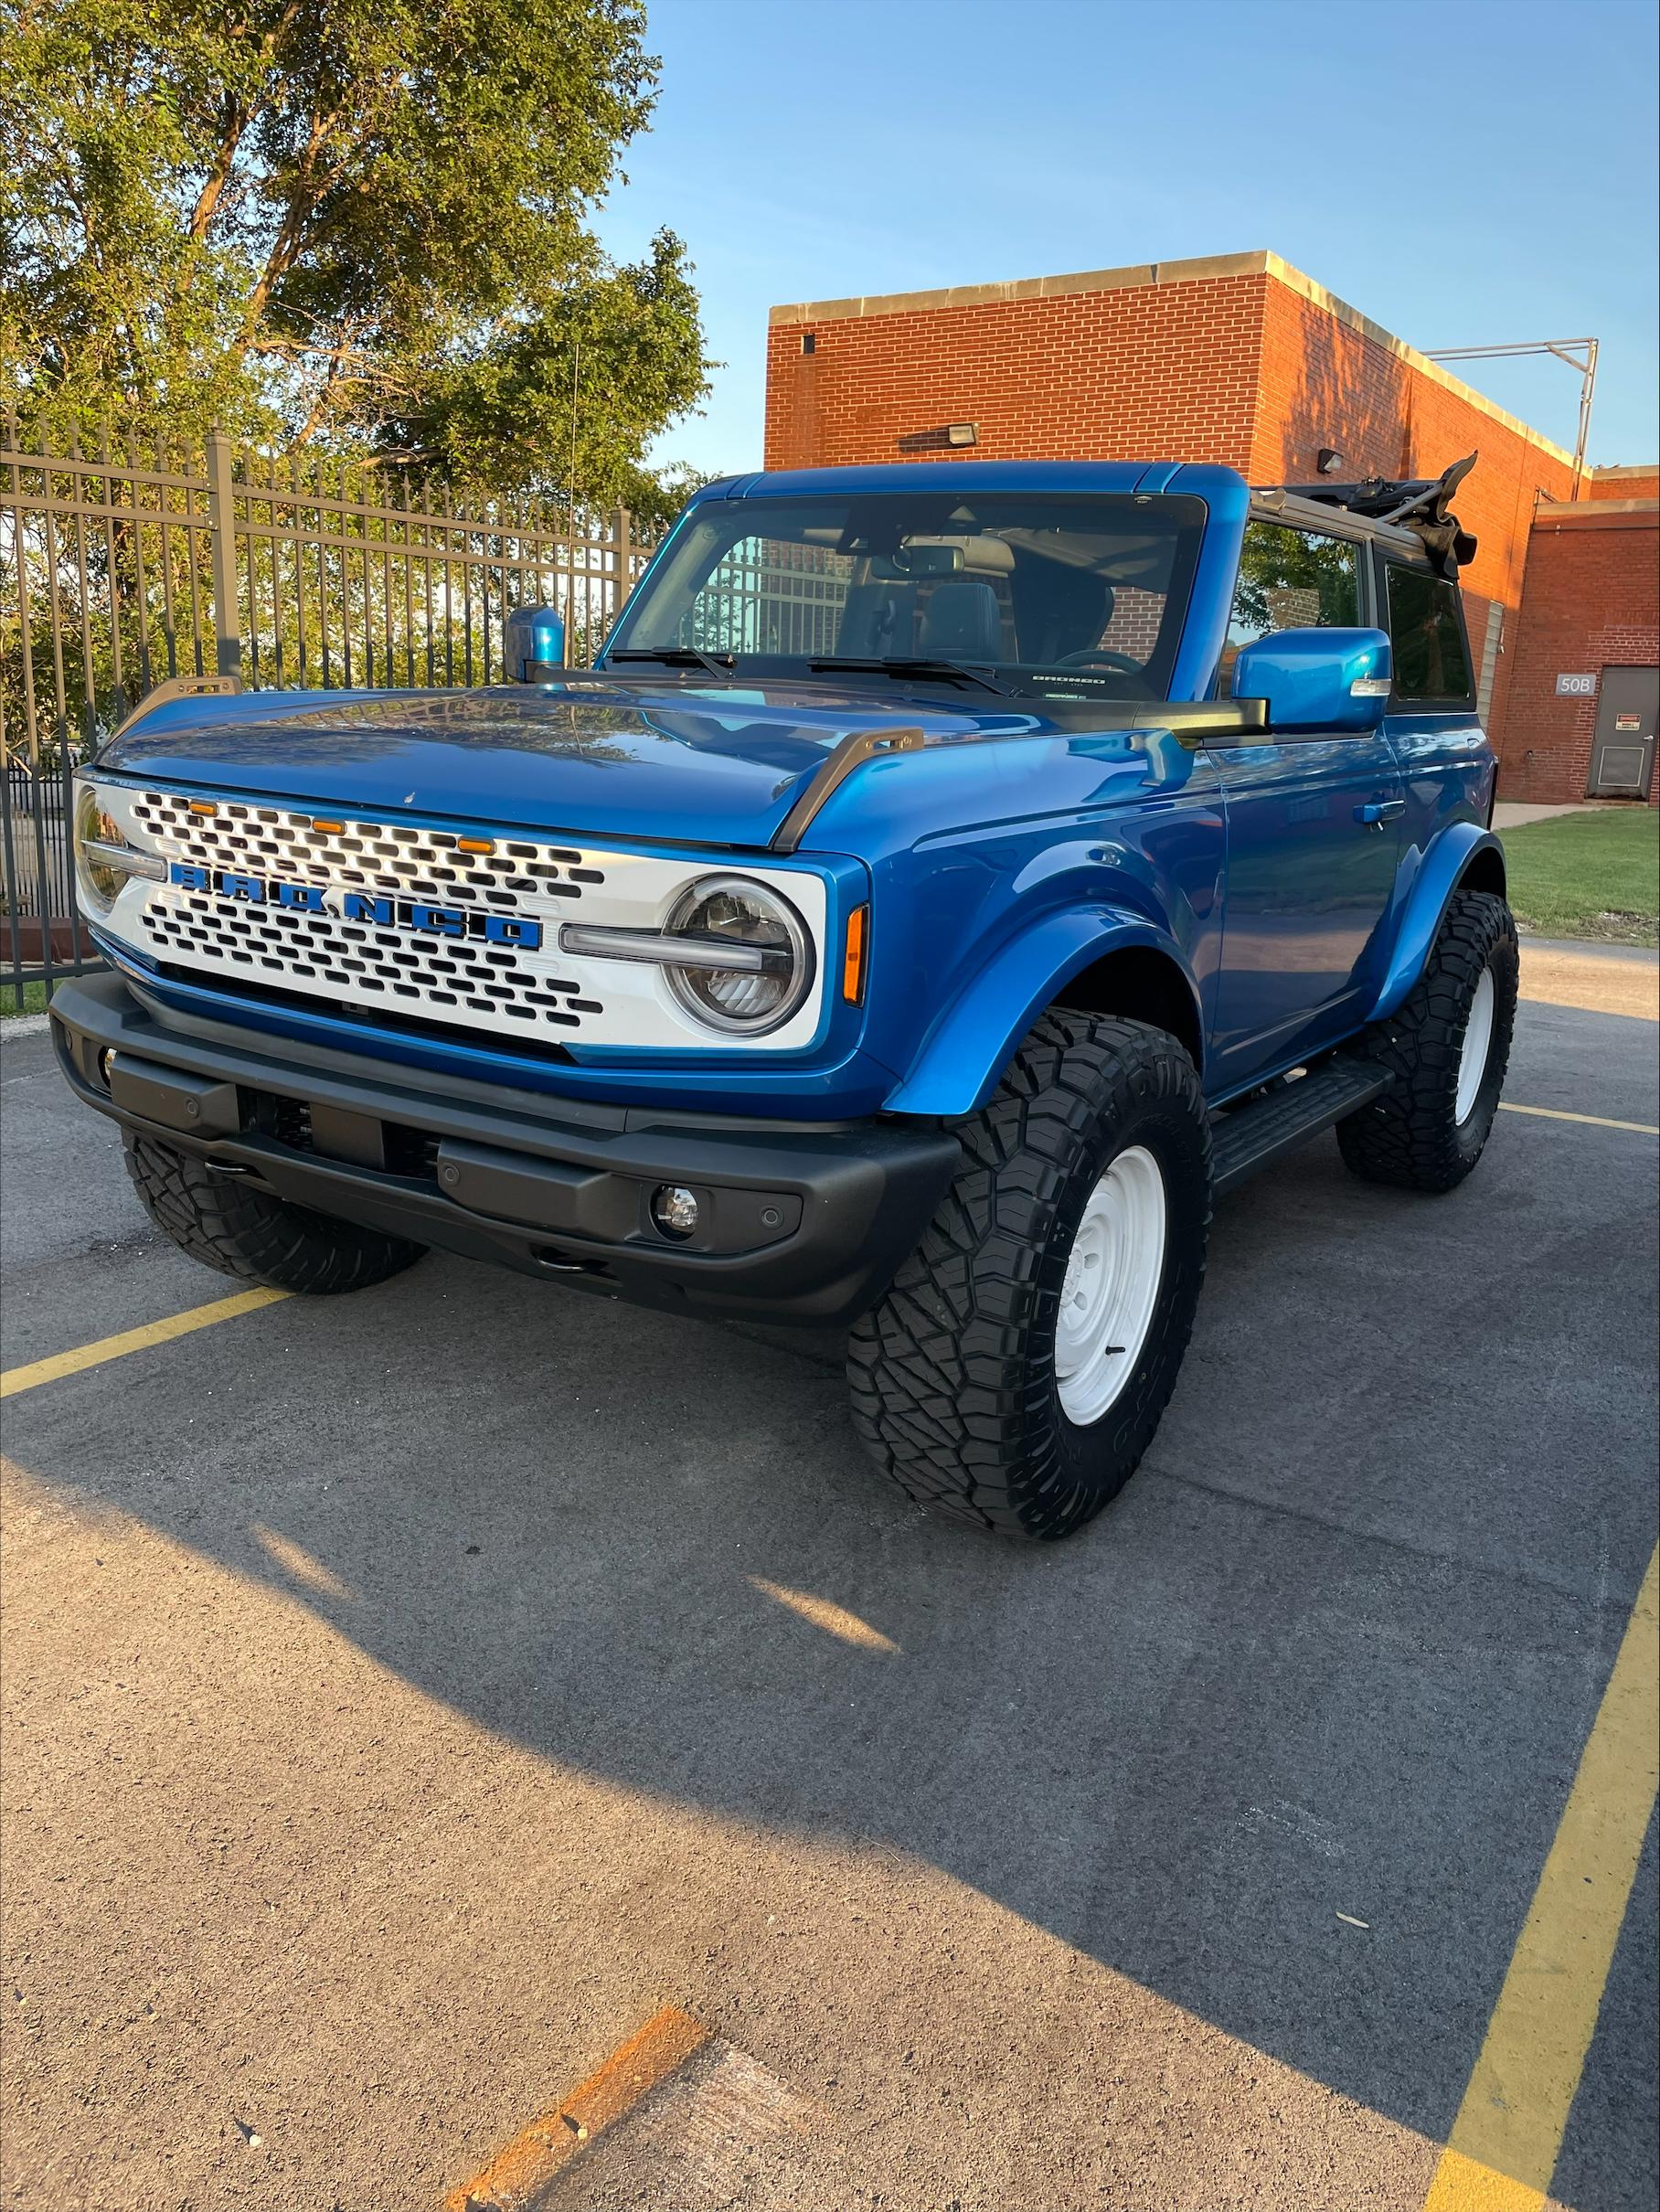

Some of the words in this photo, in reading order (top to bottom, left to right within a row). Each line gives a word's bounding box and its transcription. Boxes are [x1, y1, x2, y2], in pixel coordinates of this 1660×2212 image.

[1032, 675, 1105, 685] BRONCO
[1560, 678, 1590, 692] 50B
[170, 862, 542, 950] BRONCO
